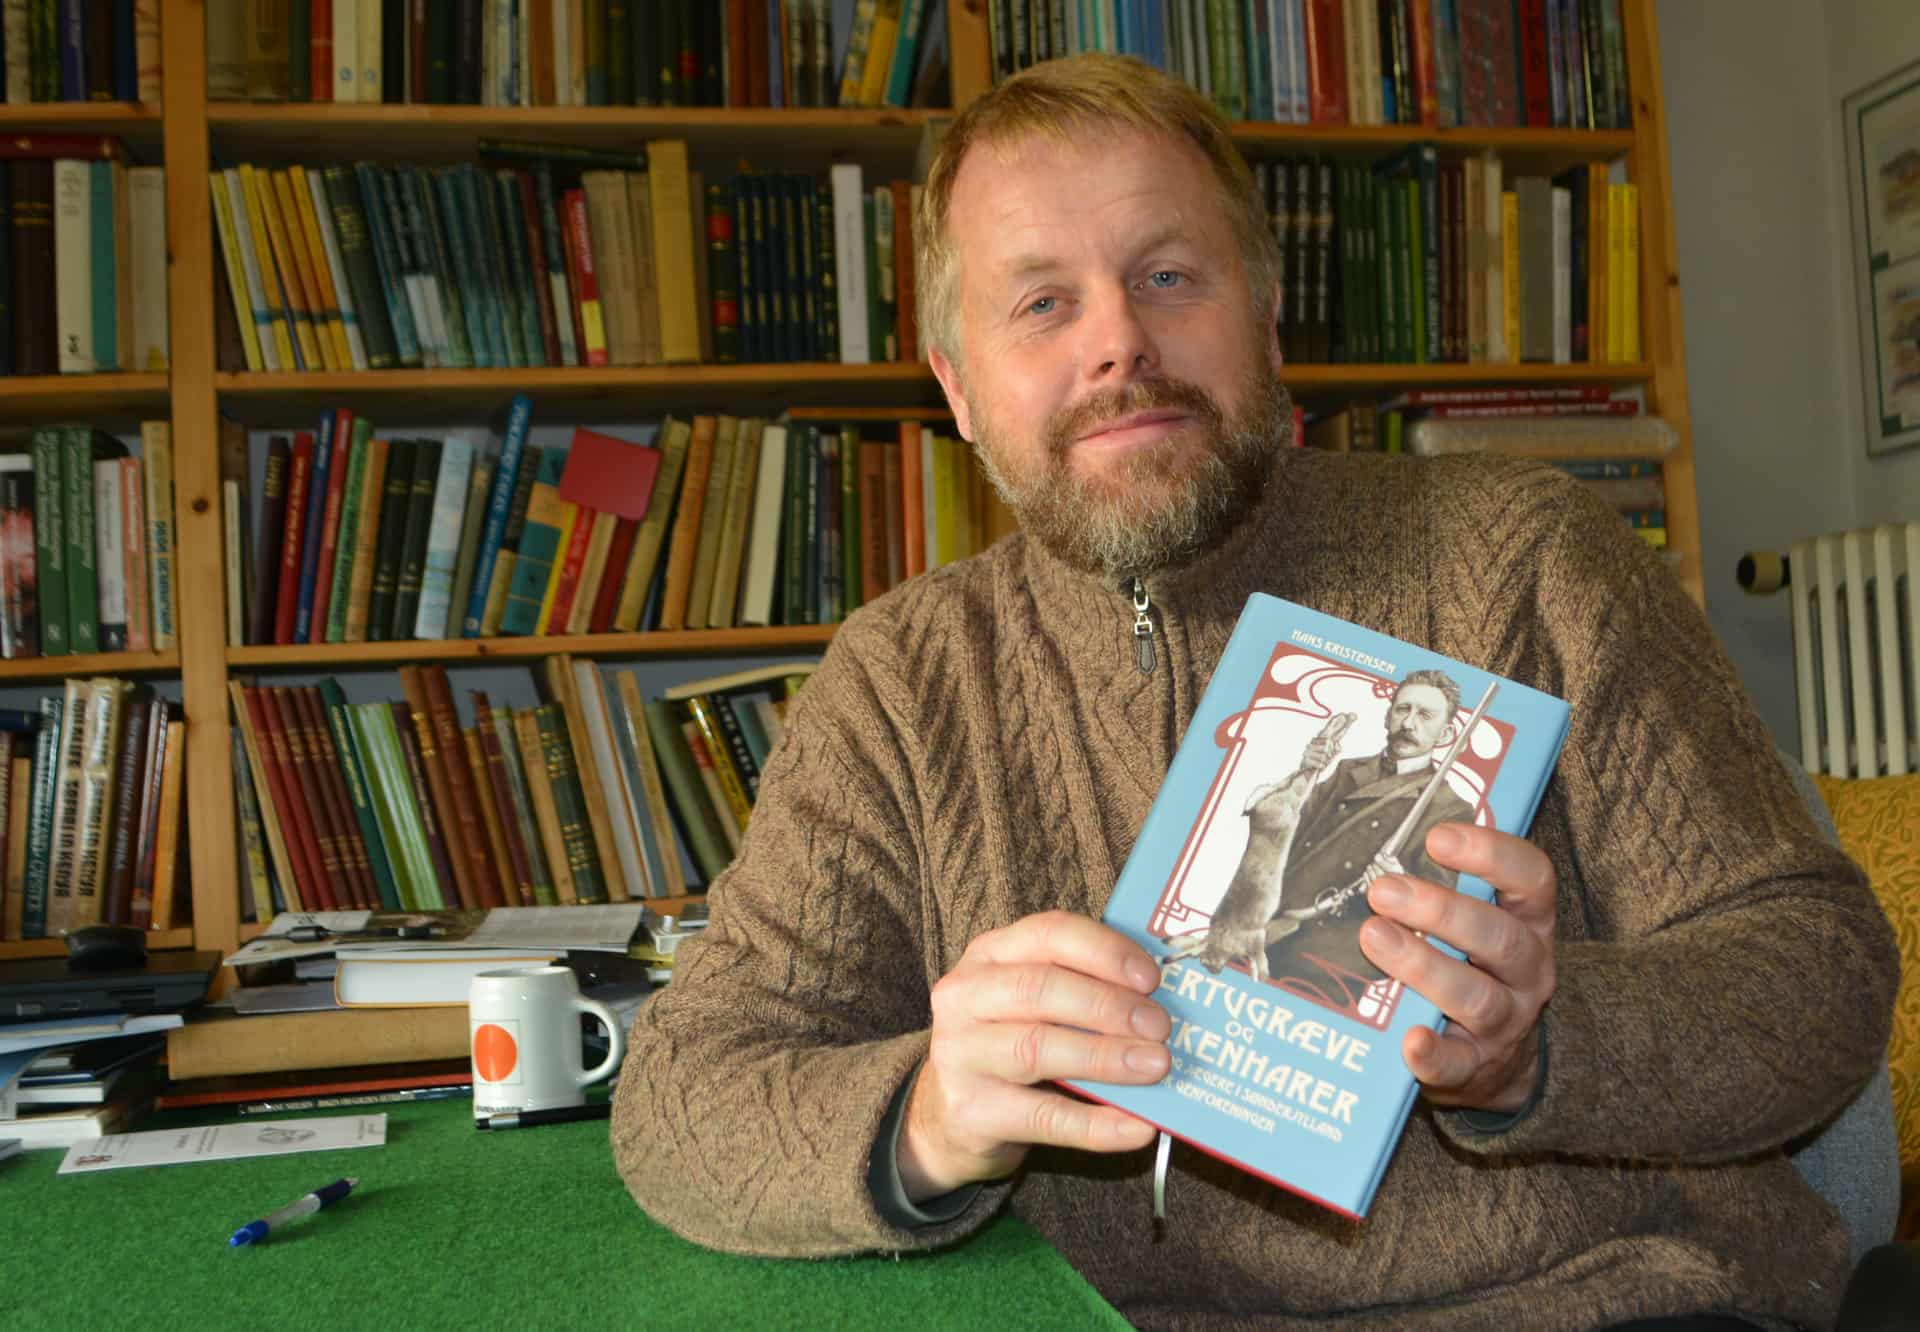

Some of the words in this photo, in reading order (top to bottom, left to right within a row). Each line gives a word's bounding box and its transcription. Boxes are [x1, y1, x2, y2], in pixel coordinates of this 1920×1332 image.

[1291, 628, 1323, 649] HANS
[1324, 640, 1397, 675] KRISTENSEN
[1159, 960, 1372, 1073] ERTUGRÆVE
[1224, 1020, 1255, 1045] OG
[1170, 1016, 1361, 1126] KENHARER
